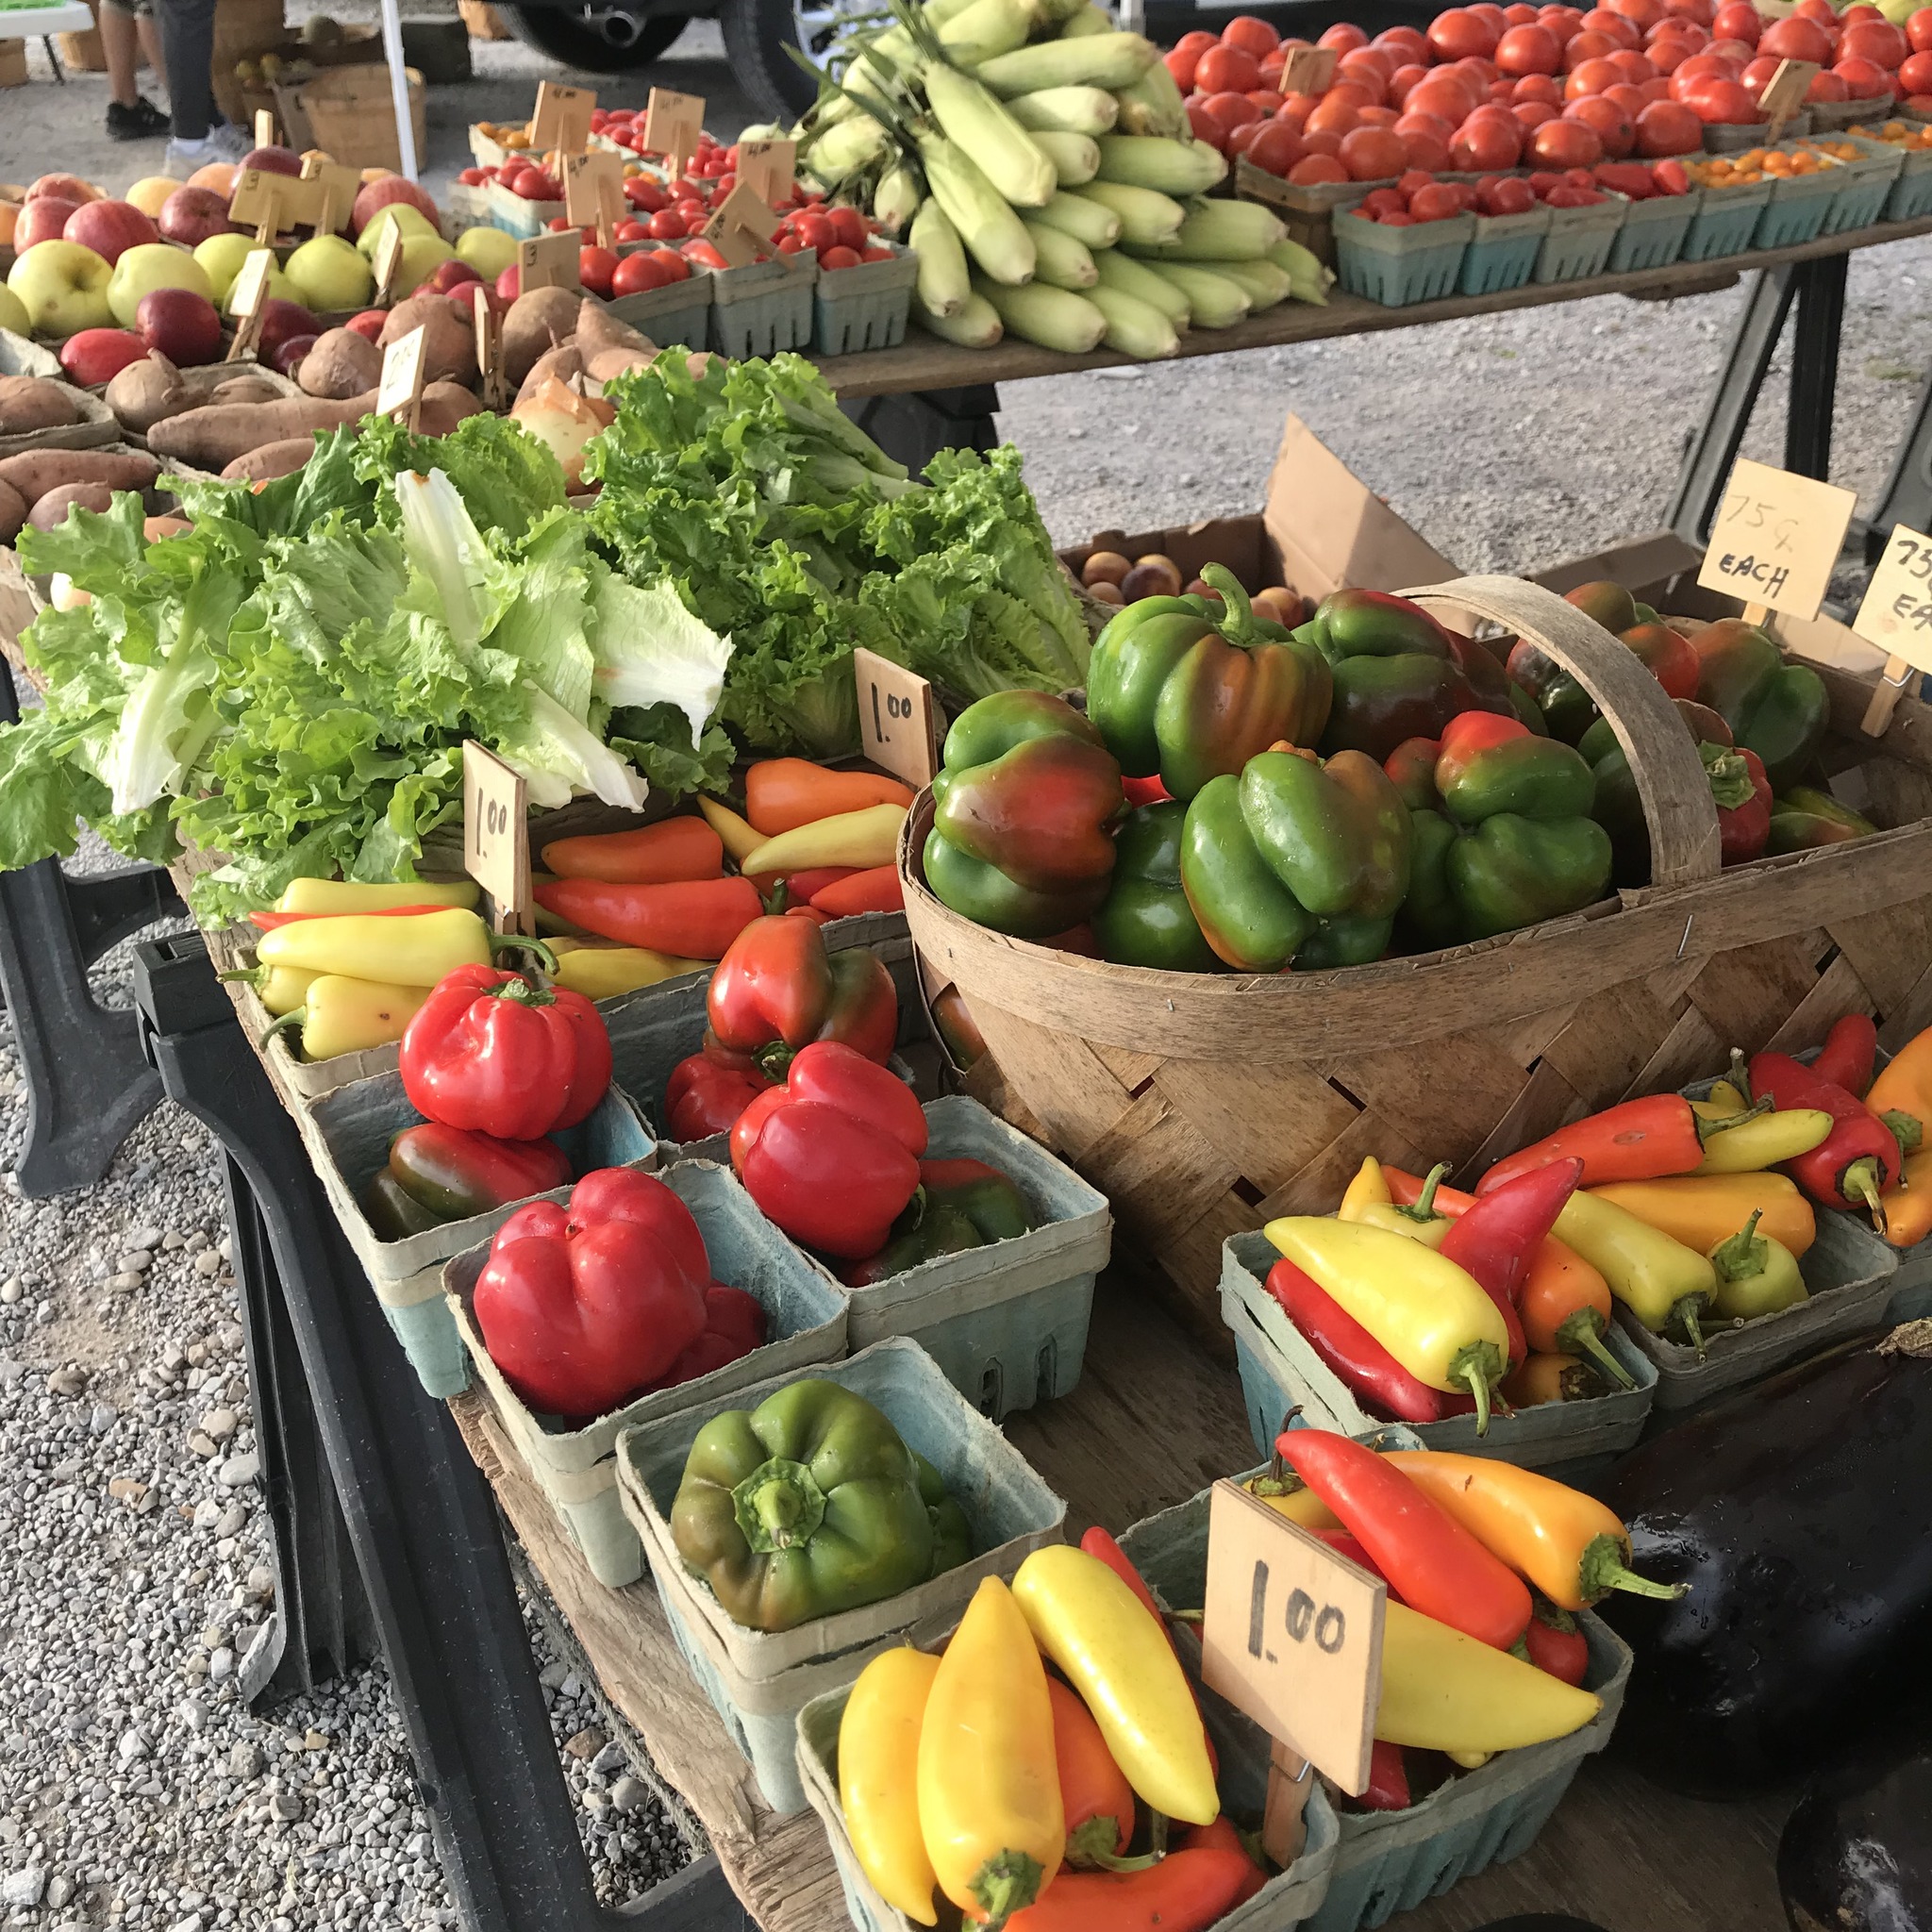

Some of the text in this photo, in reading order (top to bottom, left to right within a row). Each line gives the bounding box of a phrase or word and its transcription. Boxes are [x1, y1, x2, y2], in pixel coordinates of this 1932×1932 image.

[1718, 553, 1790, 600] EACH
[871, 682, 912, 743] 1.00
[475, 787, 508, 859] 1.00
[1248, 1559, 1346, 1665] 1.00
